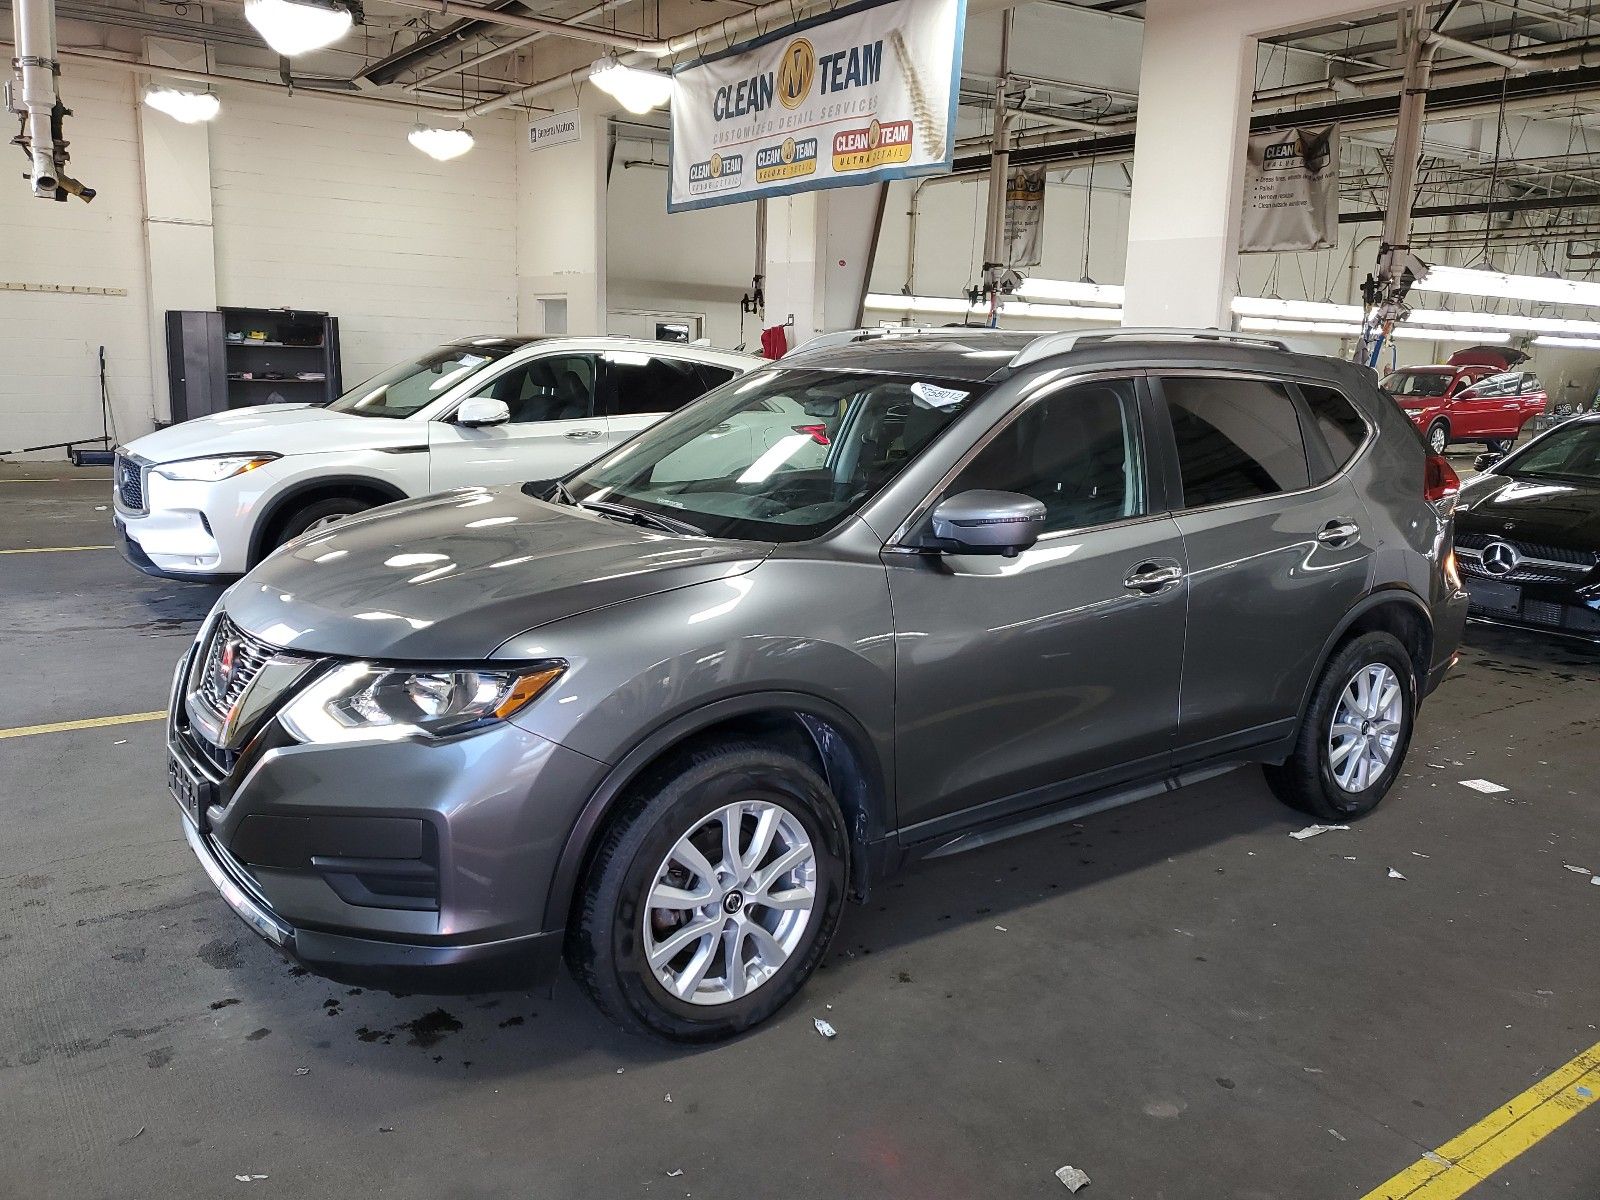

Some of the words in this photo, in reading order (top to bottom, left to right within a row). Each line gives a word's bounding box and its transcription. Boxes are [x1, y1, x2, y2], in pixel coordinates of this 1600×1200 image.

[713, 71, 774, 122] CLEAN
[818, 39, 884, 96] TEAM
[713, 119, 773, 145] CUSTOMIZED
[778, 110, 814, 130] DETAIL
[820, 94, 879, 120] SERVICES
[836, 132, 869, 152] CLEAN
[880, 124, 909, 144] TEAM
[757, 148, 781, 167] CLEAN
[795, 140, 816, 160] TEAM
[840, 154, 870, 166] ULTRA
[1266, 144, 1295, 158] CLEAN
[1266, 159, 1295, 168] VALUE
[690, 163, 711, 180] CLEAN
[722, 157, 742, 174] TEAM
